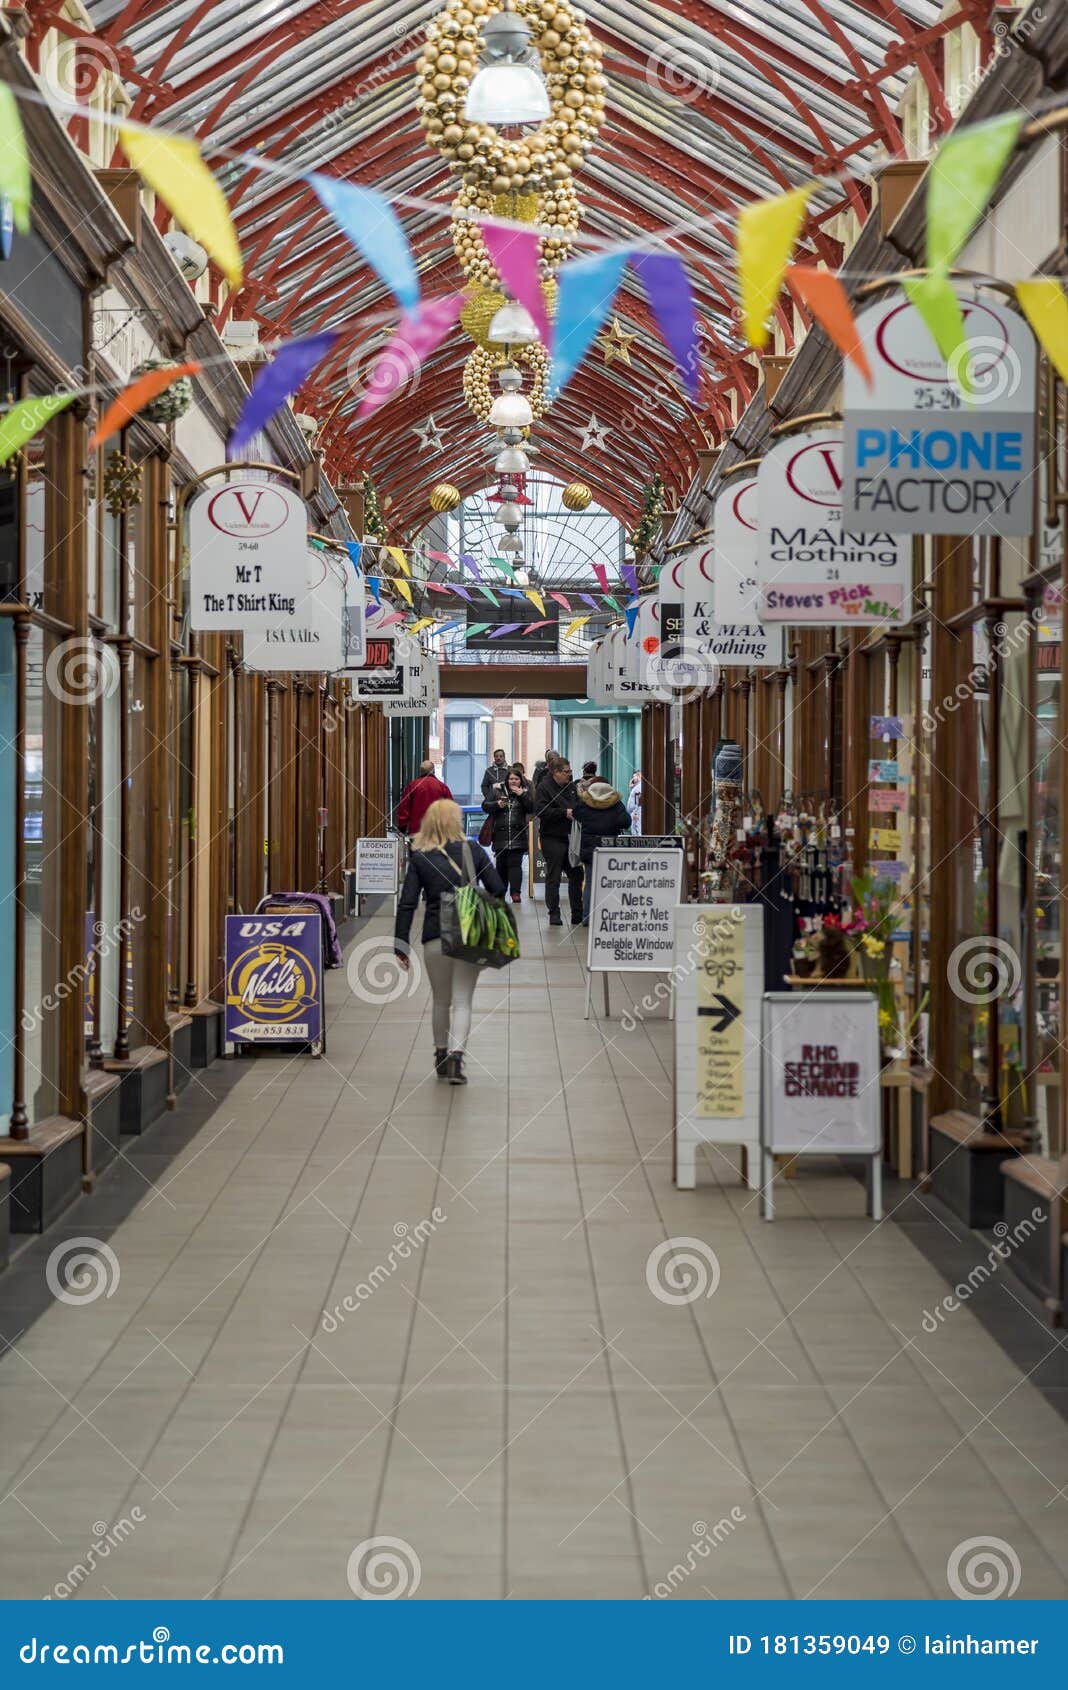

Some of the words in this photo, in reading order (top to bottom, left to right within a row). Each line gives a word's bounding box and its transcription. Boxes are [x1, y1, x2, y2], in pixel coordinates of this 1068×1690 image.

[856, 428, 1022, 471] PHONE
[854, 478, 1021, 514] FACTORY
[232, 491, 264, 525] V
[769, 528, 898, 546] MANA
[770, 547, 897, 566] clothing
[235, 565, 252, 583] Mr
[253, 565, 262, 582] T
[203, 594, 225, 612] The
[226, 594, 235, 611] T
[238, 593, 265, 611] Shirt
[268, 593, 295, 615] King
[767, 590, 824, 608] Steve's
[828, 583, 873, 606] Pick
[864, 599, 900, 619] Mix
[698, 638, 768, 659] clothing
[608, 858, 668, 871] Curtains
[601, 876, 636, 888] Caravan
[637, 876, 675, 888] Curtains
[621, 893, 654, 906] Nets
[601, 908, 638, 920] Curtain
[641, 910, 647, 919] +
[650, 908, 669, 920] Net
[239, 921, 306, 937] USA
[599, 921, 668, 932] Alterations
[594, 937, 633, 949] Peelable
[636, 937, 674, 949] Window
[614, 949, 653, 961] Stickers
[242, 956, 301, 1005] Nails
[802, 1044, 838, 1062] RHC
[783, 1061, 860, 1080] SECOND
[783, 1079, 860, 1097] CHANCE
